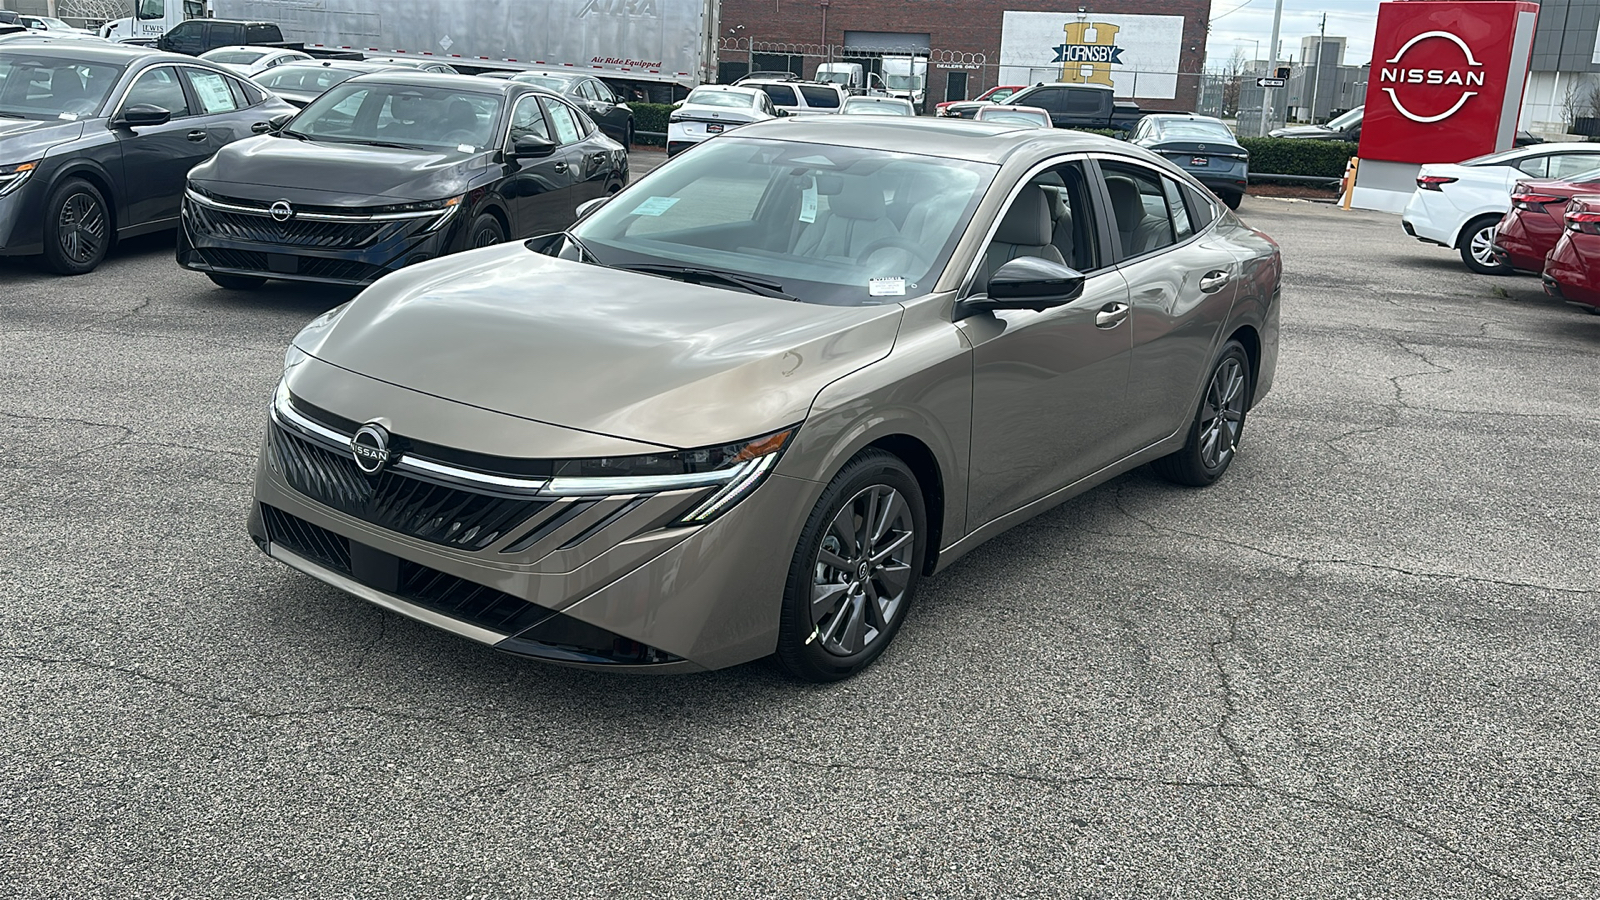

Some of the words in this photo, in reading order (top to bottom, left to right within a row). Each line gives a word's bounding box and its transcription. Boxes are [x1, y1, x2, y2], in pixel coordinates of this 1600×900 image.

[143, 25, 163, 33] LEWIS
[1062, 45, 1116, 62] HORNSBY
[604, 57, 623, 65] Ride
[624, 59, 662, 68] Equipped
[1380, 67, 1485, 86] NISSAN
[350, 442, 387, 461] NISSAN
